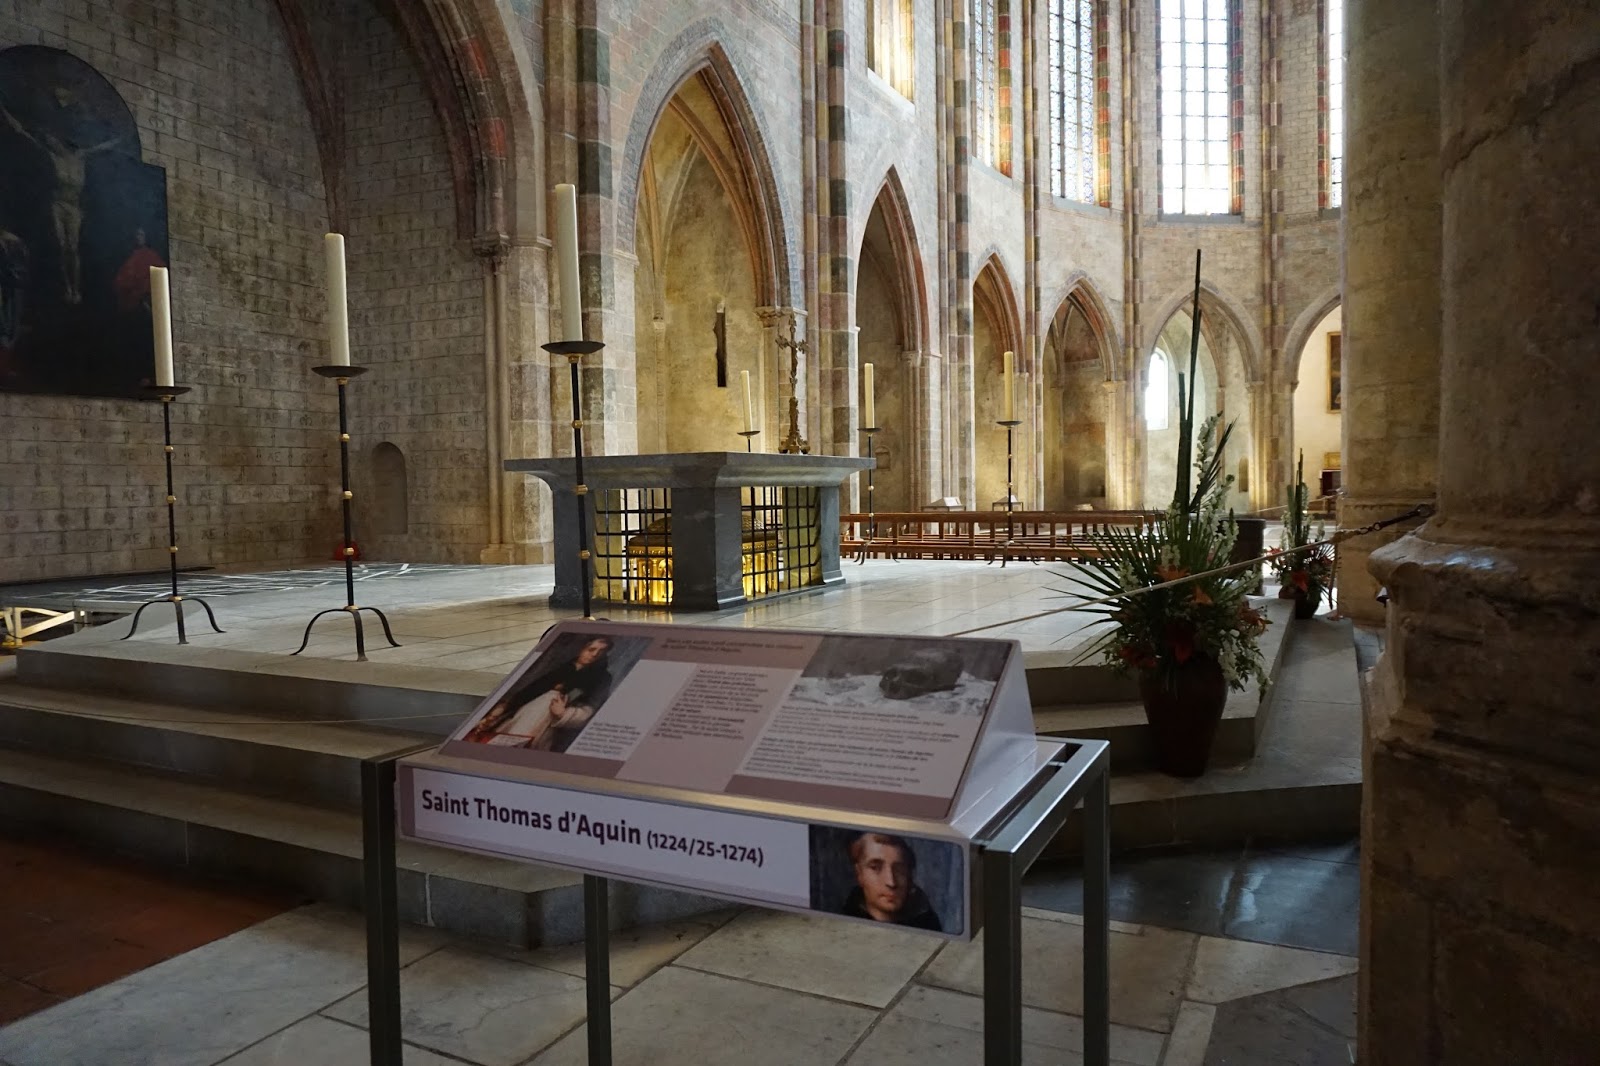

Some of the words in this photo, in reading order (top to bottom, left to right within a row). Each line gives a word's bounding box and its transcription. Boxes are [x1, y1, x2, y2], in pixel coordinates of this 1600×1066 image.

[422, 789, 469, 817] Saint
[473, 797, 552, 830] Thomas
[558, 811, 641, 845] d’Aquin
[646, 830, 764, 868] (1224/25-1274)
